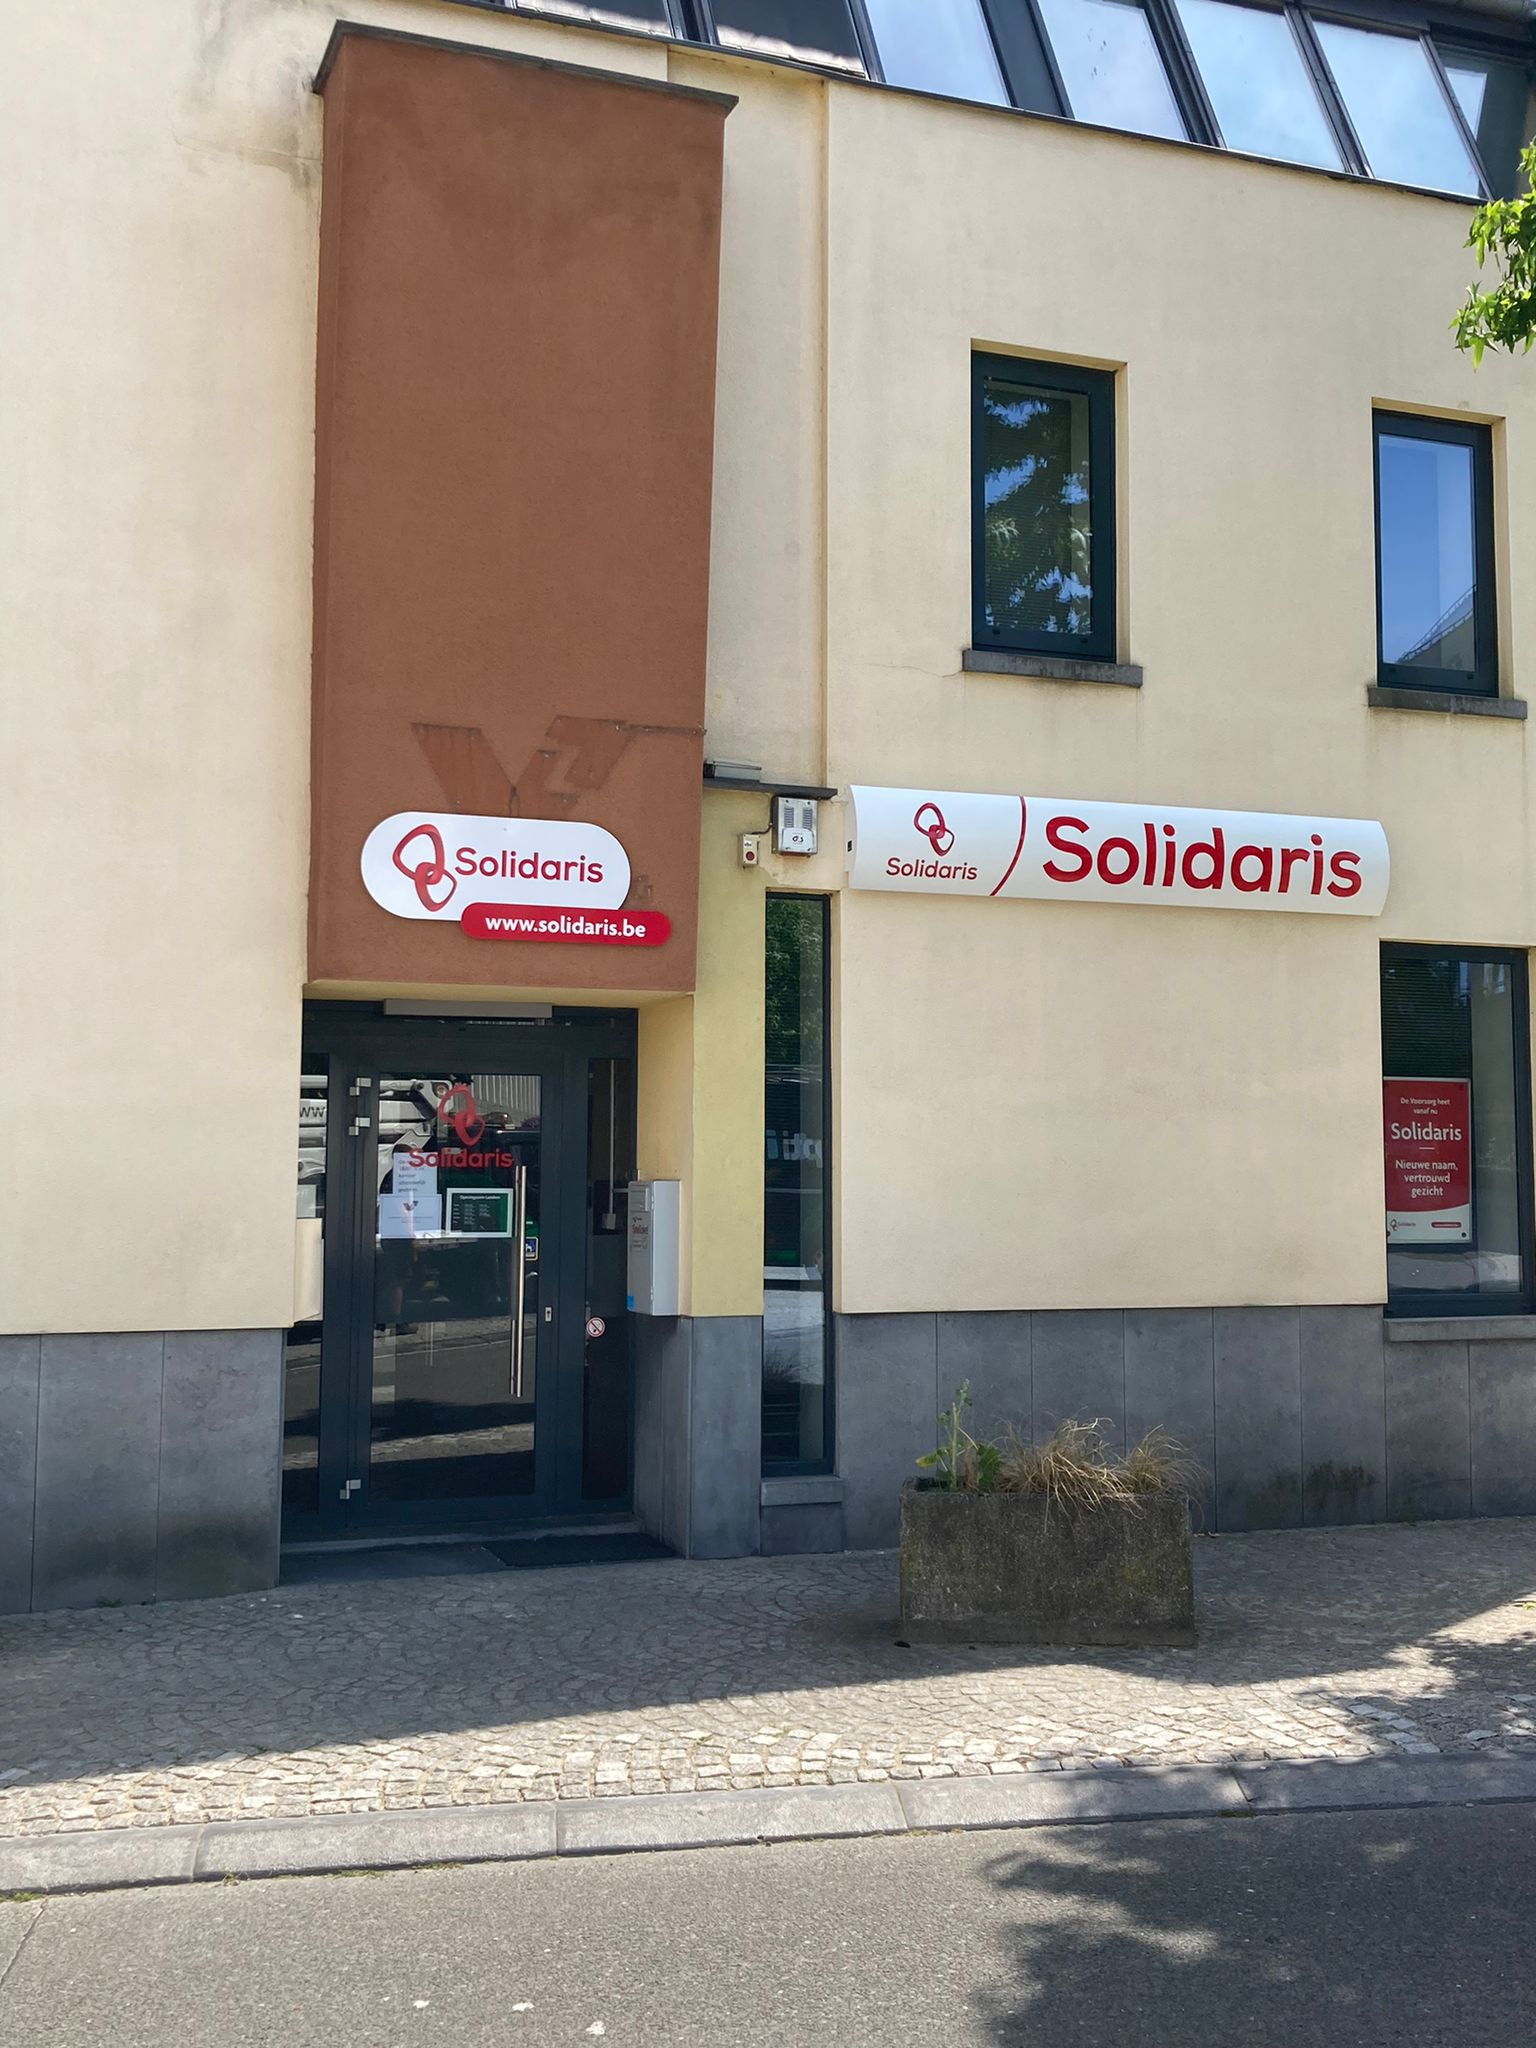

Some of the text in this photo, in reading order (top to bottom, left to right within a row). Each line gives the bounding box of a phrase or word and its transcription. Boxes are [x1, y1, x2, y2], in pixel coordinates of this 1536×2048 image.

[455, 847, 604, 884] Solidaris
[1042, 815, 1363, 898] Solidaris
[886, 857, 978, 881] Solidaris
[485, 915, 647, 939] www.solidaris.be
[1391, 1122, 1462, 1141] Solidaris
[408, 1148, 513, 1168] Solidaris
[1395, 1160, 1458, 1171] Nieuwe naam,
[1404, 1173, 1450, 1183] vertrouwd
[1411, 1186, 1443, 1198] gezicht
